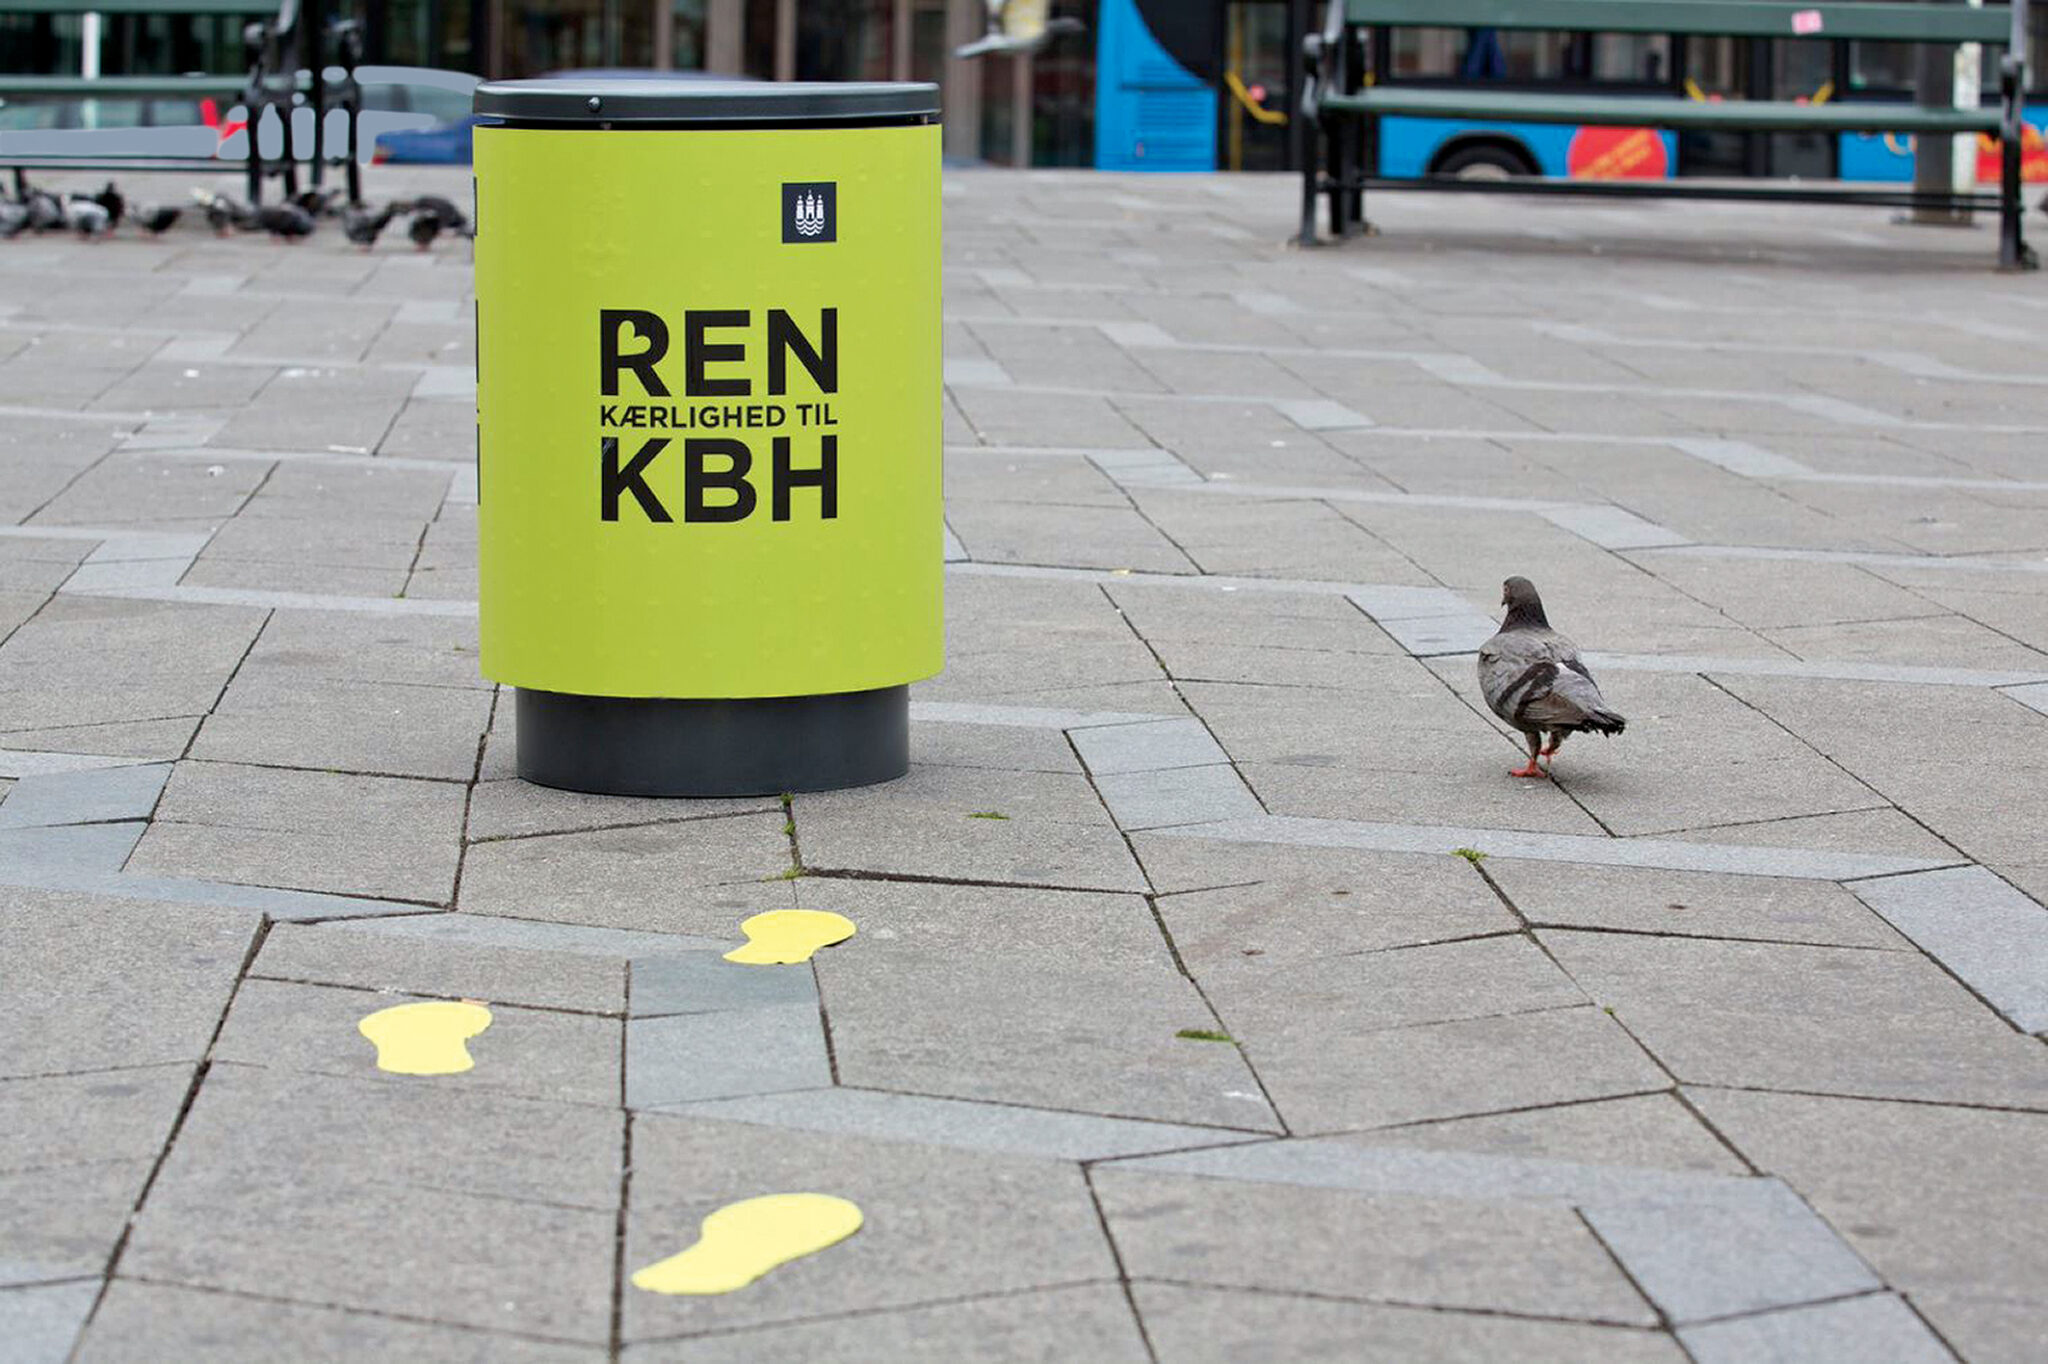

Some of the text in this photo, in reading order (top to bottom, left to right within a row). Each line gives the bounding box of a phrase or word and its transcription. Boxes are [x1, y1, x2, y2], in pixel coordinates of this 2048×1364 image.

[599, 307, 839, 398] REN
[599, 403, 839, 429] KÆRLIGHED TIL
[600, 434, 839, 524] KBH
